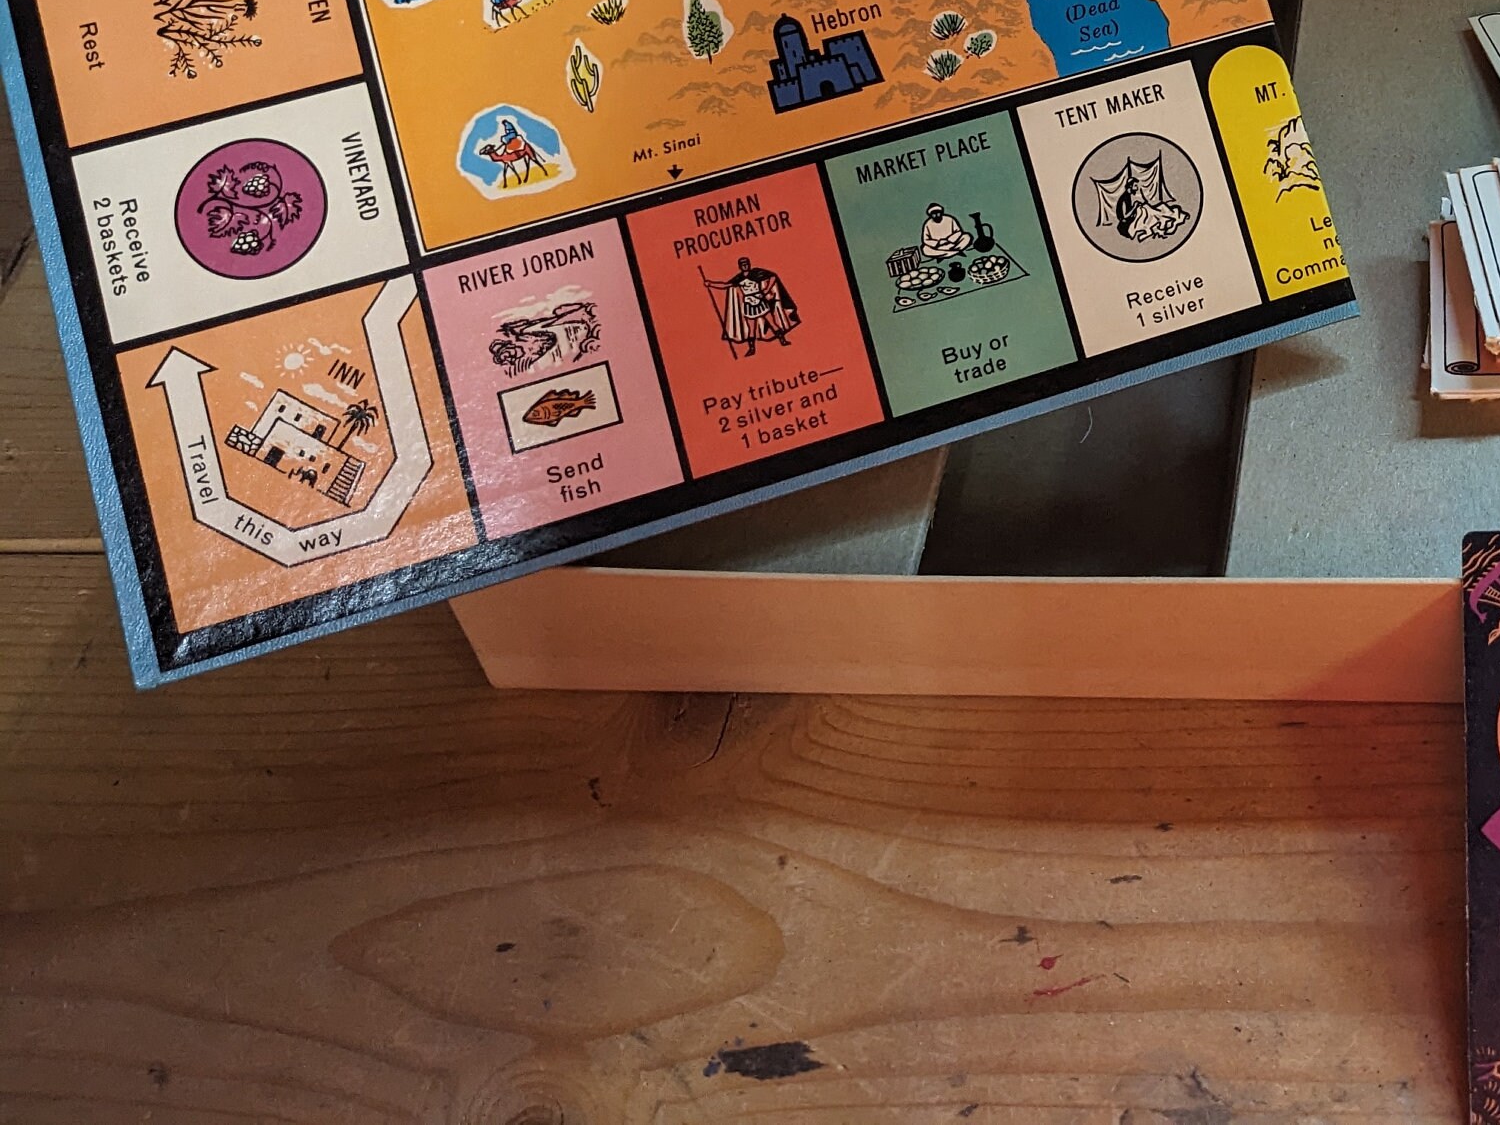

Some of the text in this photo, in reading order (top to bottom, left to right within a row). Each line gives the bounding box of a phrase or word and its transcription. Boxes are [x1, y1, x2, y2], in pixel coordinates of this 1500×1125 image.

[810, 1, 882, 34] Hebron
[1079, 20, 1119, 44] Sea)
[79, 21, 102, 71] Rest
[1055, 83, 1166, 129] TENT MAKER
[1255, 82, 1286, 104] MT.
[633, 134, 701, 163] Mt. Sinai
[856, 132, 992, 185] MARKET PLACE
[340, 131, 379, 220] VINEYARD
[693, 194, 761, 228] ROMAN
[93, 198, 128, 297] 2 baskets
[118, 198, 150, 283] Receive
[673, 211, 793, 259] PROCURATOR
[458, 240, 595, 294] RIVER JORDAN
[1126, 274, 1205, 309] Receive
[1136, 296, 1206, 327] 1 silver
[941, 333, 1009, 368] Buy or
[328, 359, 366, 390] INN
[954, 357, 1007, 384] trade
[702, 391, 743, 415] Pay
[718, 384, 838, 434] 2 silver and
[741, 411, 829, 448] 1 basket
[545, 453, 605, 485] Send
[184, 434, 343, 553] Travel this way
[559, 480, 603, 504] fish
